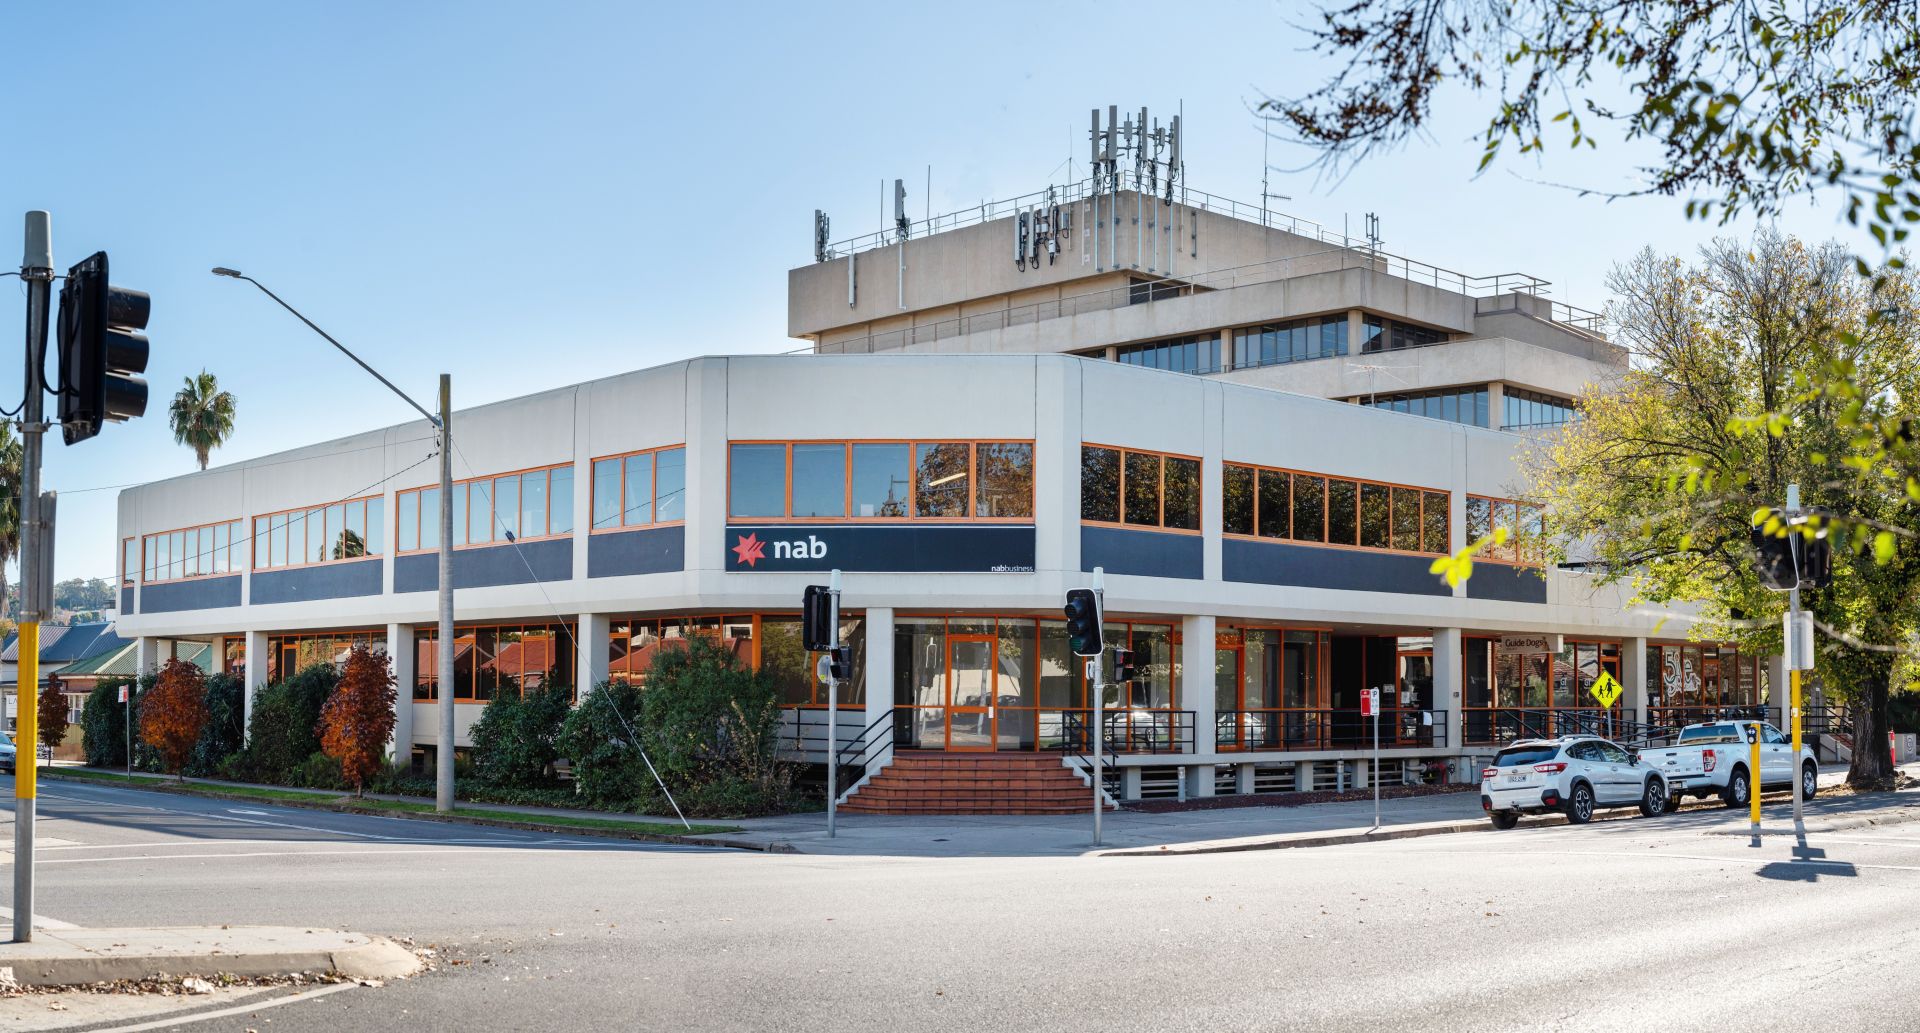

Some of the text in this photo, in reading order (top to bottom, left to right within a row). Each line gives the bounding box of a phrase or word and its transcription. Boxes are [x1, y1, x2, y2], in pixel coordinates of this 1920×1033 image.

[773, 534, 828, 559] nab
[991, 564, 1034, 572] nabbusiness
[1505, 638, 1544, 649] Guide Dogs
